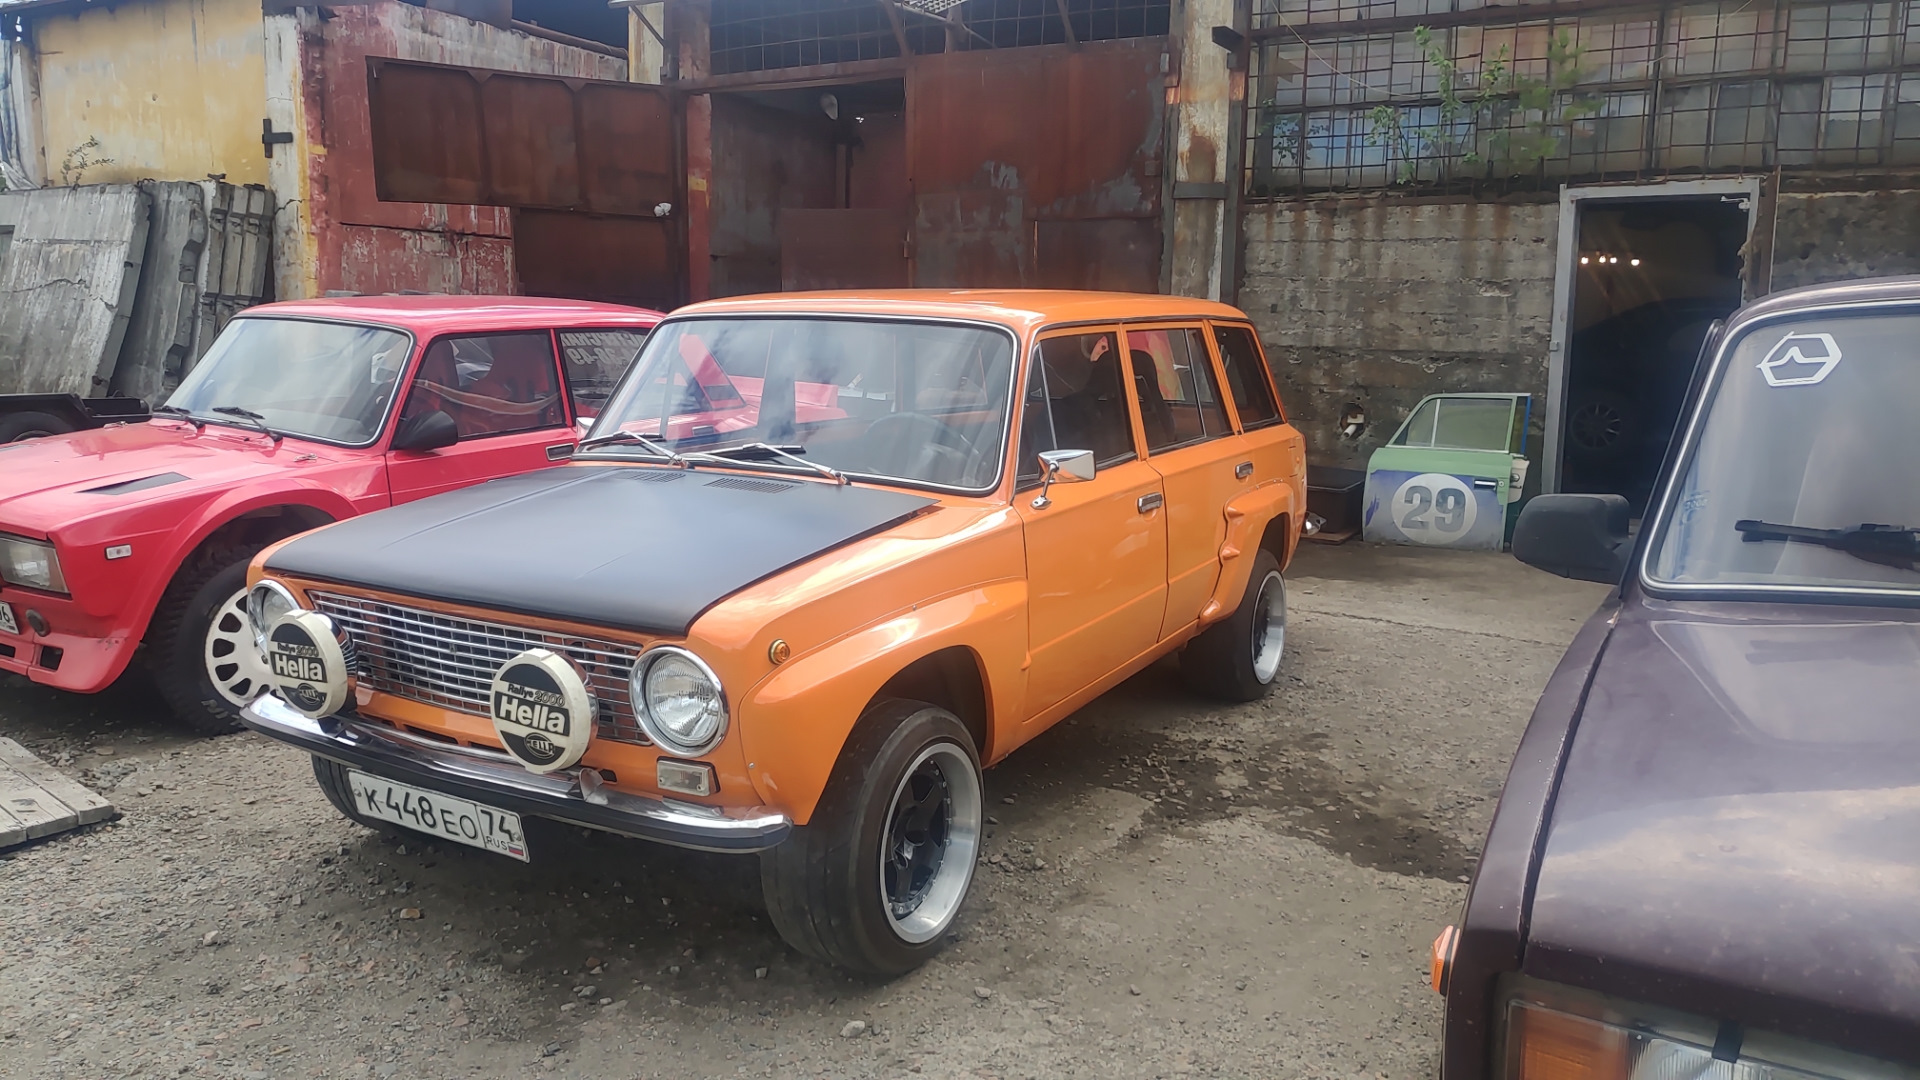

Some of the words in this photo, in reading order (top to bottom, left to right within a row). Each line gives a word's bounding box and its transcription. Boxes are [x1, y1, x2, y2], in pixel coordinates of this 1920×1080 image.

[1401, 485, 1467, 533] 29
[274, 653, 323, 681] Hella
[507, 683, 534, 699] Rallye
[533, 691, 565, 708] 2000
[499, 694, 566, 734] Hella
[480, 809, 515, 842] 74
[485, 835, 508, 851] RUS
